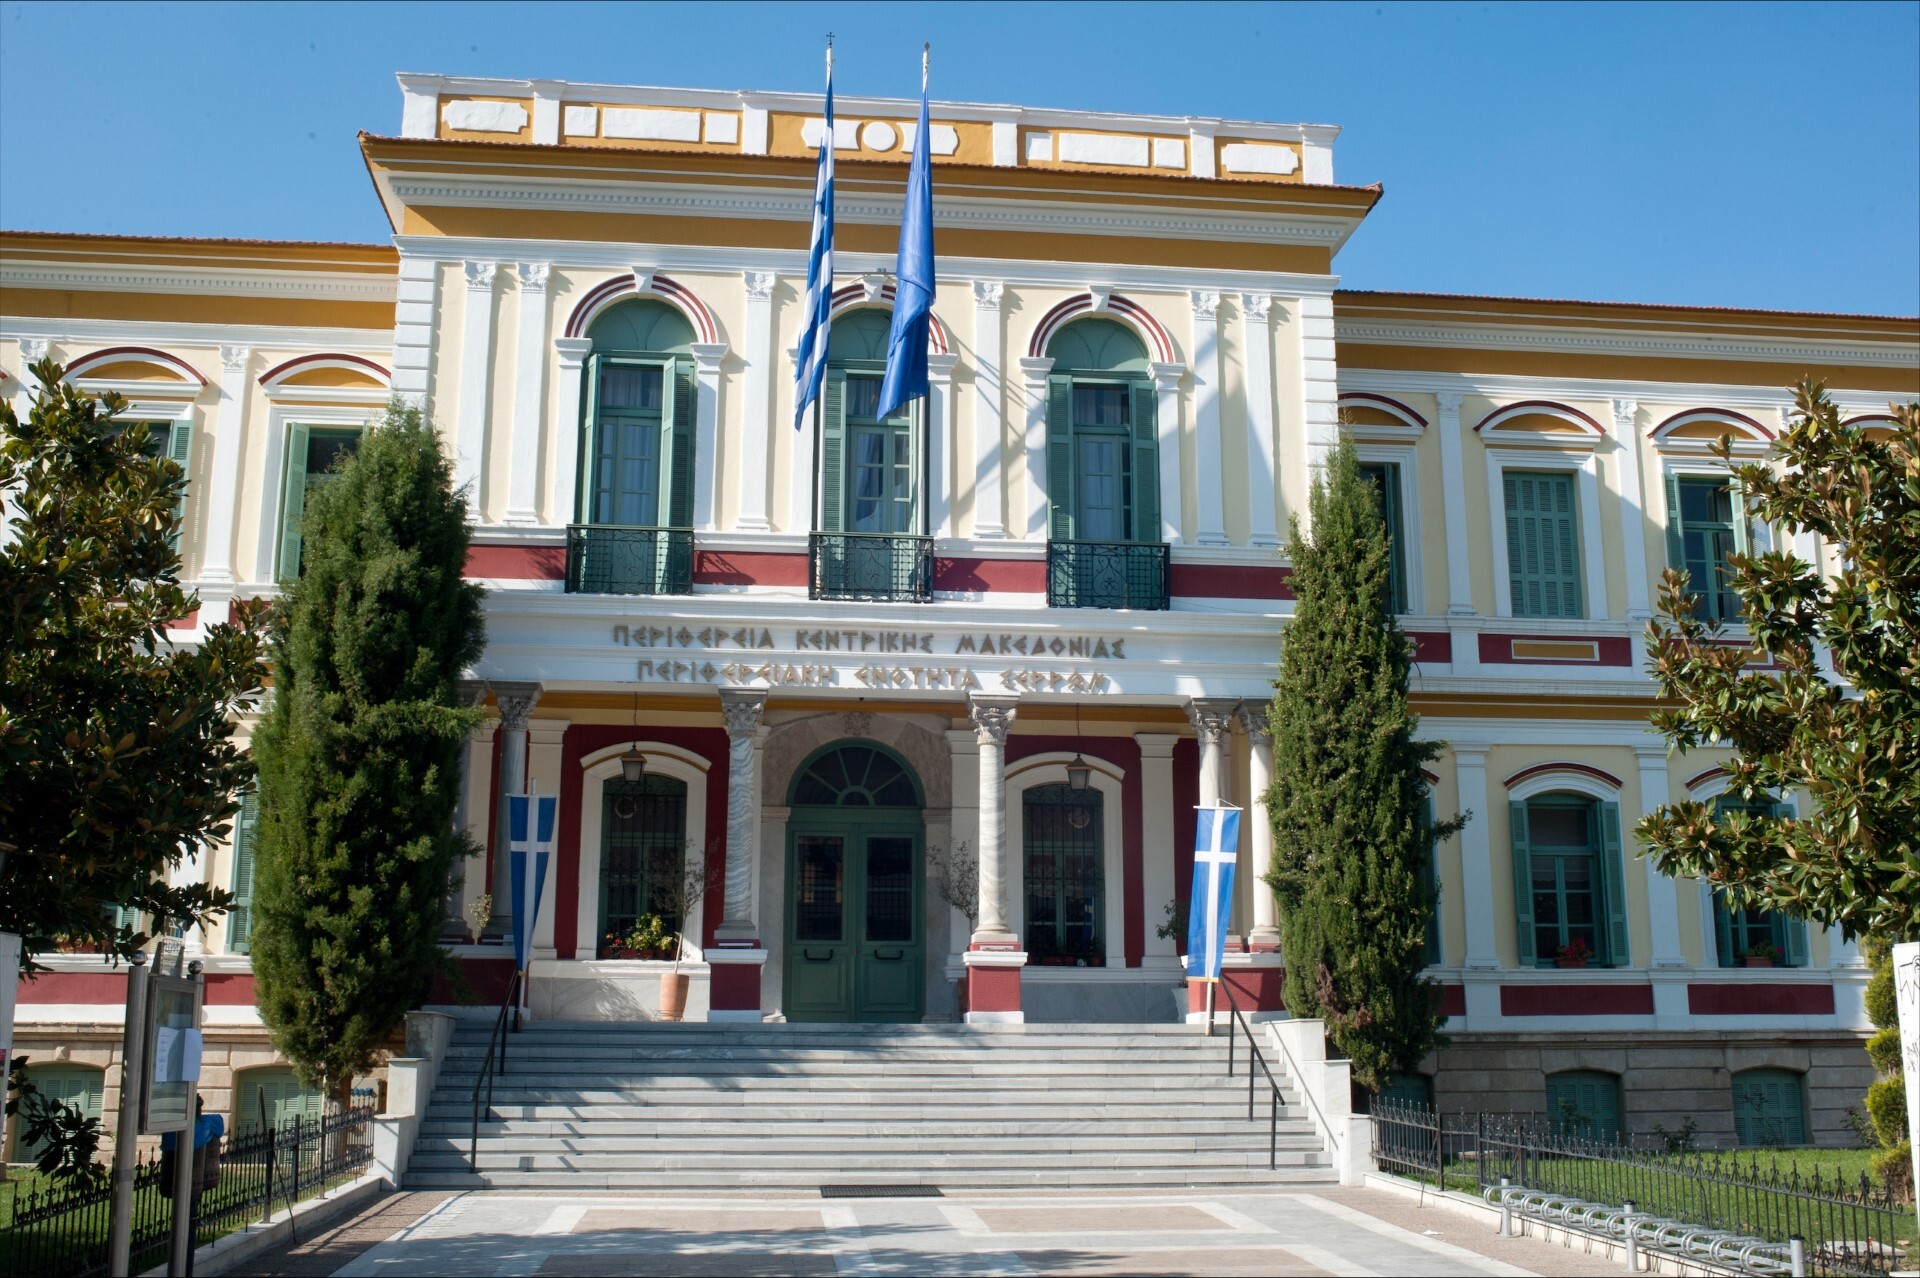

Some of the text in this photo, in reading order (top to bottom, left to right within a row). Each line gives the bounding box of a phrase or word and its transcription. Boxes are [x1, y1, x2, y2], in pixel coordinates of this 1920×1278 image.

[613, 624, 1126, 659] ΠΕΡΙΦΕΡΕΙΑ ΚΕΝΤΡΙΚΗΣ ΜΑΚΕΔΟΝΙΑΣ
[638, 660, 1106, 692] ΠΕΡΙΦΕΡΕΙΑΚΗ ΕΝΟΤΗΤΑ ΣΕΡΡΩΝ
